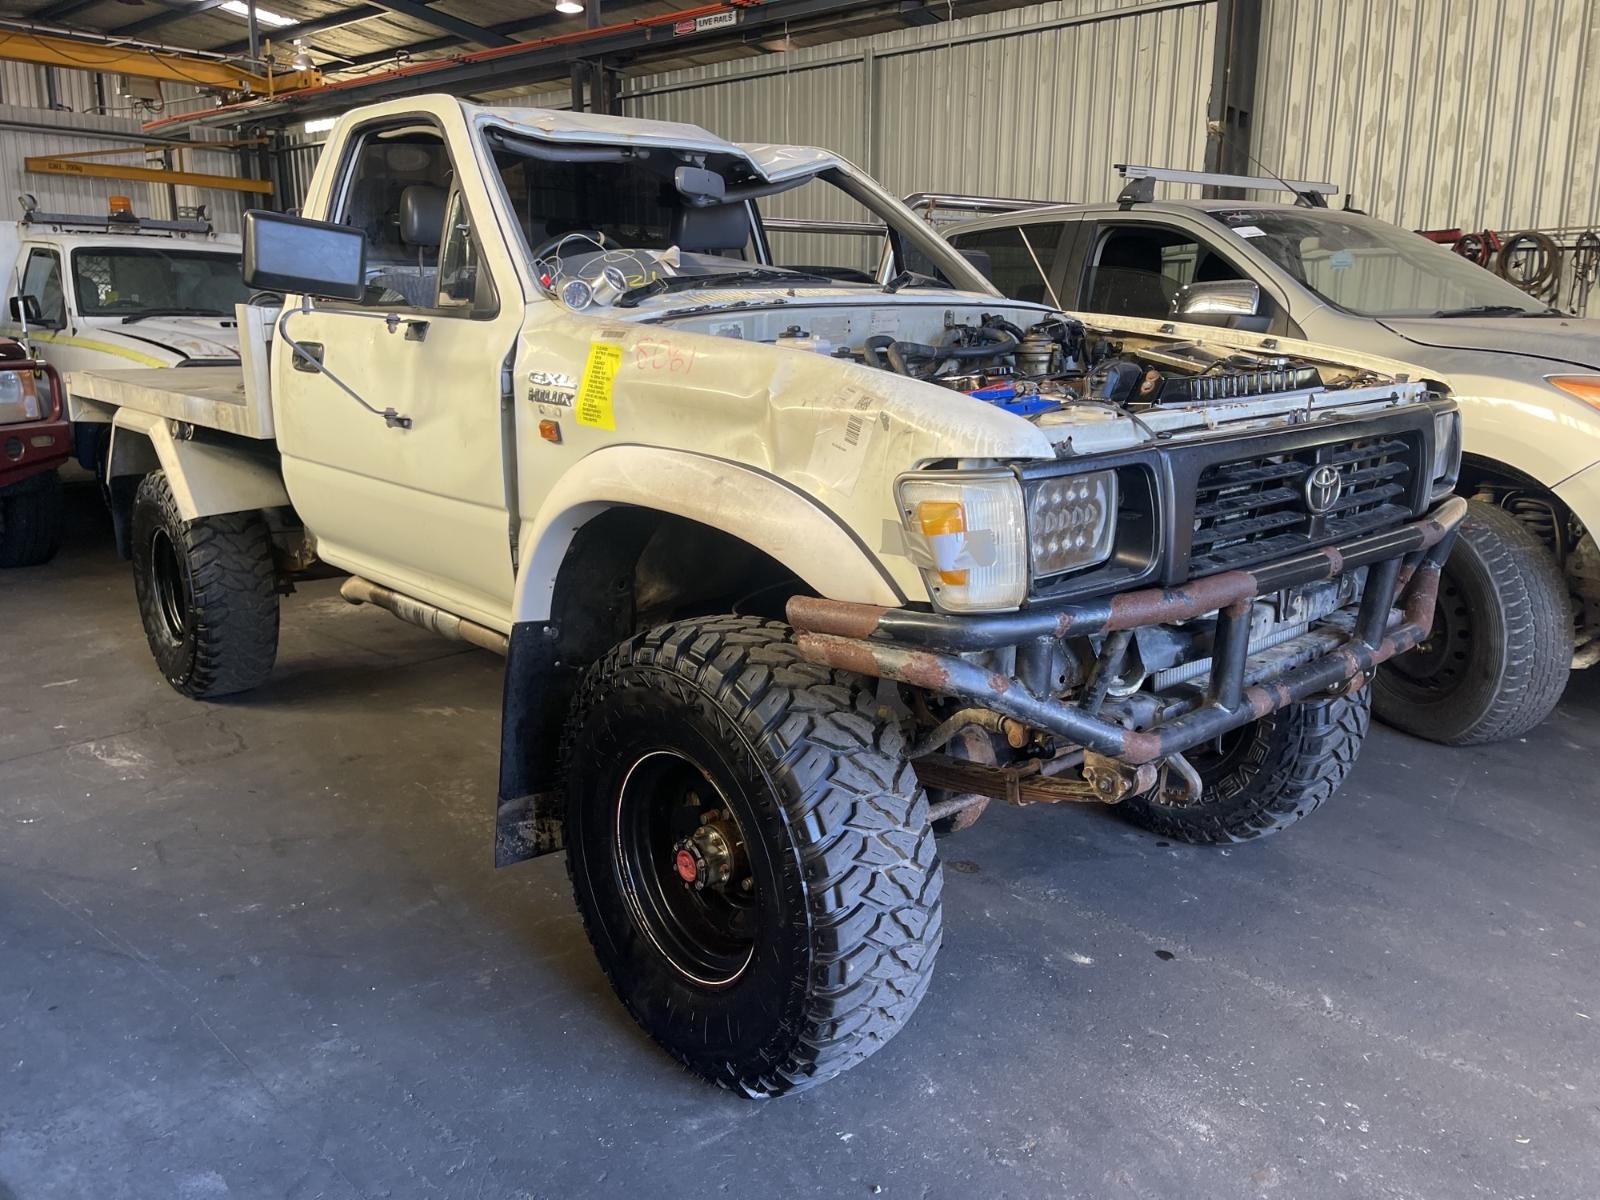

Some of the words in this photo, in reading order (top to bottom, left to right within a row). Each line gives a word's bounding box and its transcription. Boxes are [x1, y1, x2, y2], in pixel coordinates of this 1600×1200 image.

[699, 18, 713, 26] LIVE
[714, 14, 733, 24] RAILS
[529, 371, 577, 389] GXL
[528, 388, 575, 407] HILUX
[1201, 718, 1276, 803] LEVER
